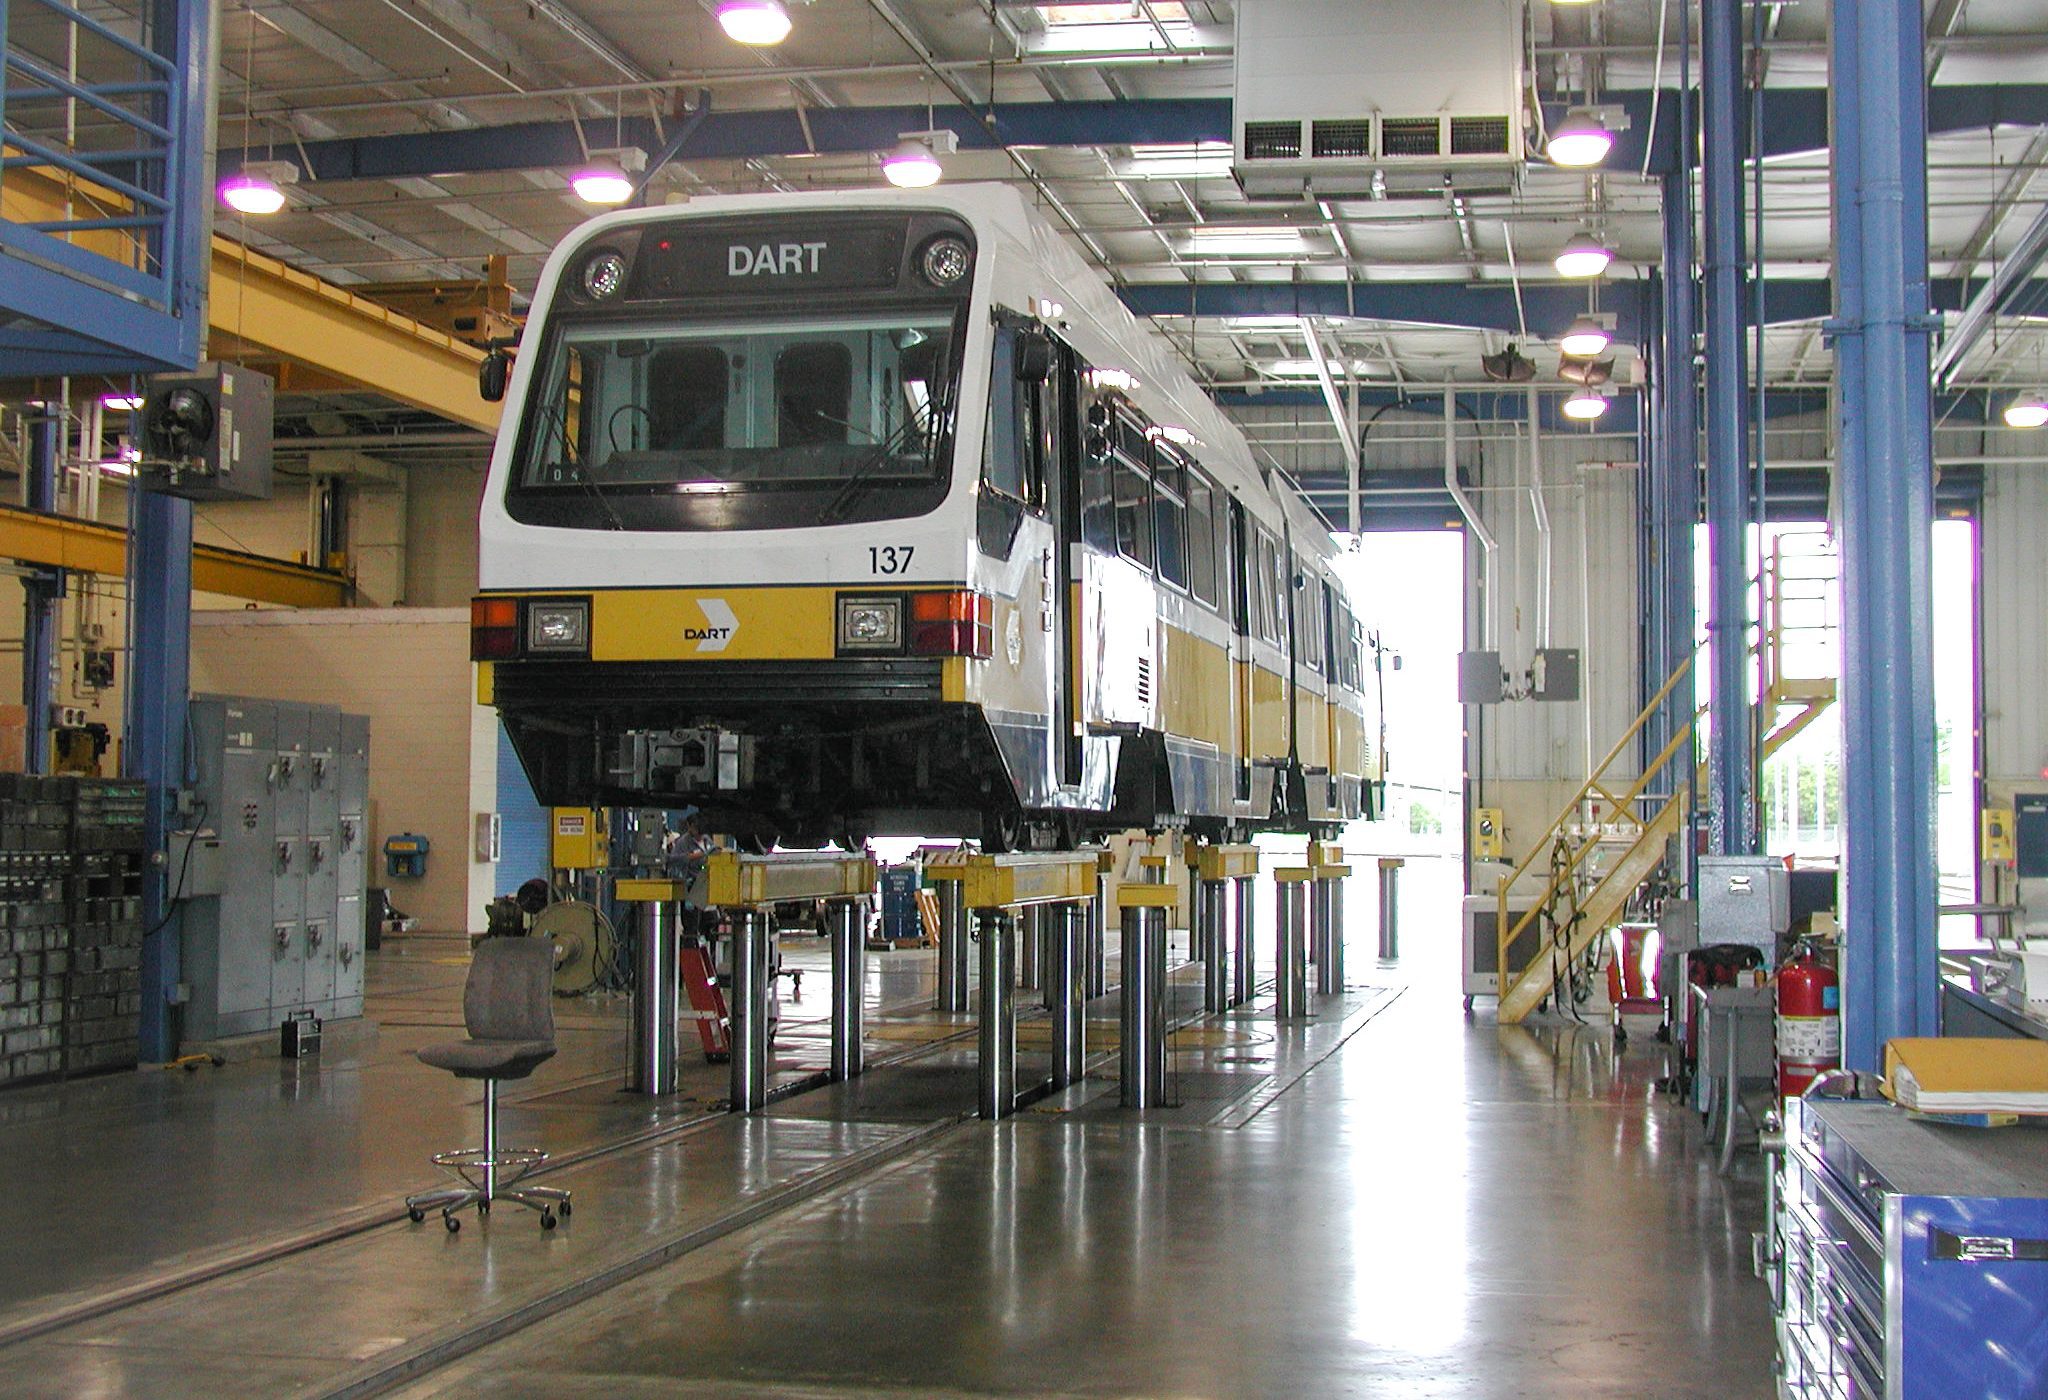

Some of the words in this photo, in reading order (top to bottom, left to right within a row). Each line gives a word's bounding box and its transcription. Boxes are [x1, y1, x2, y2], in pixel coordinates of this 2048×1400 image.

[728, 242, 827, 276] DART
[869, 546, 915, 574] 137
[684, 627, 730, 640] DART
